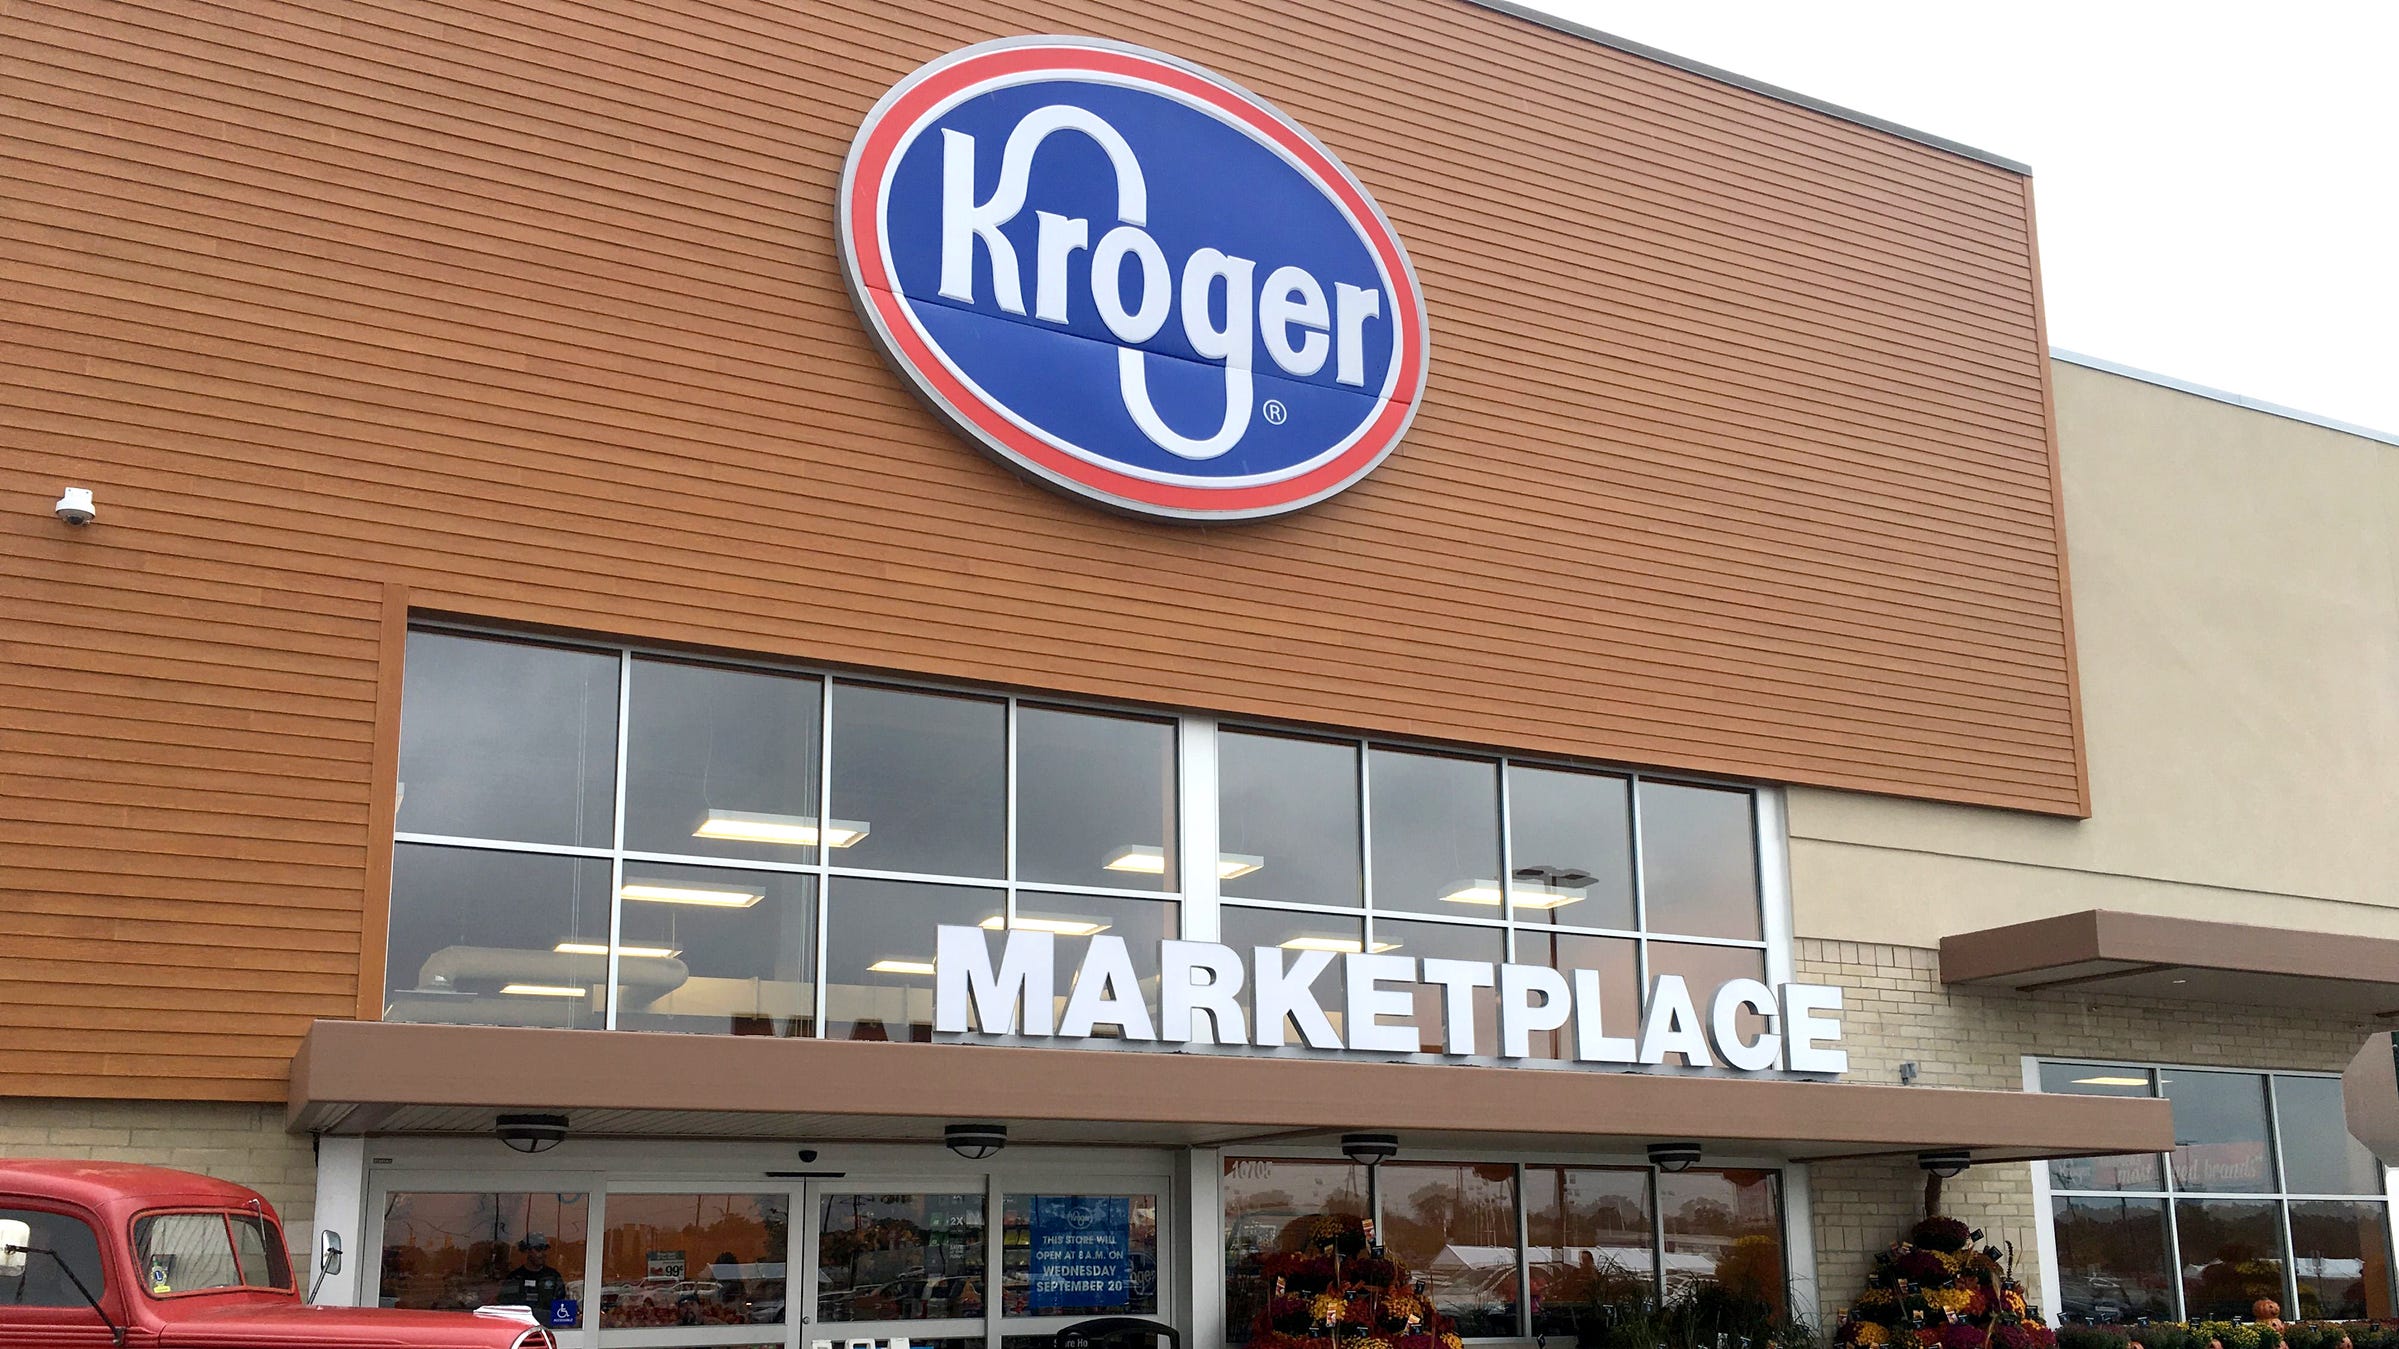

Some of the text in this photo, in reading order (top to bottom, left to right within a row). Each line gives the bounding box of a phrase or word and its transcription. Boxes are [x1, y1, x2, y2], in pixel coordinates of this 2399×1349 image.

[939, 104, 1380, 461] Kroger
[934, 924, 1849, 1074] MARKETPLACE
[1043, 1236, 1117, 1245] THIS STORE WILL
[1036, 1251, 1062, 1260] OPEN
[1064, 1251, 1075, 1260] AT
[1109, 1251, 1124, 1260] ON
[1043, 1265, 1117, 1277] WEDNESDAY
[1037, 1280, 1123, 1292] SEPTEMBER 20
